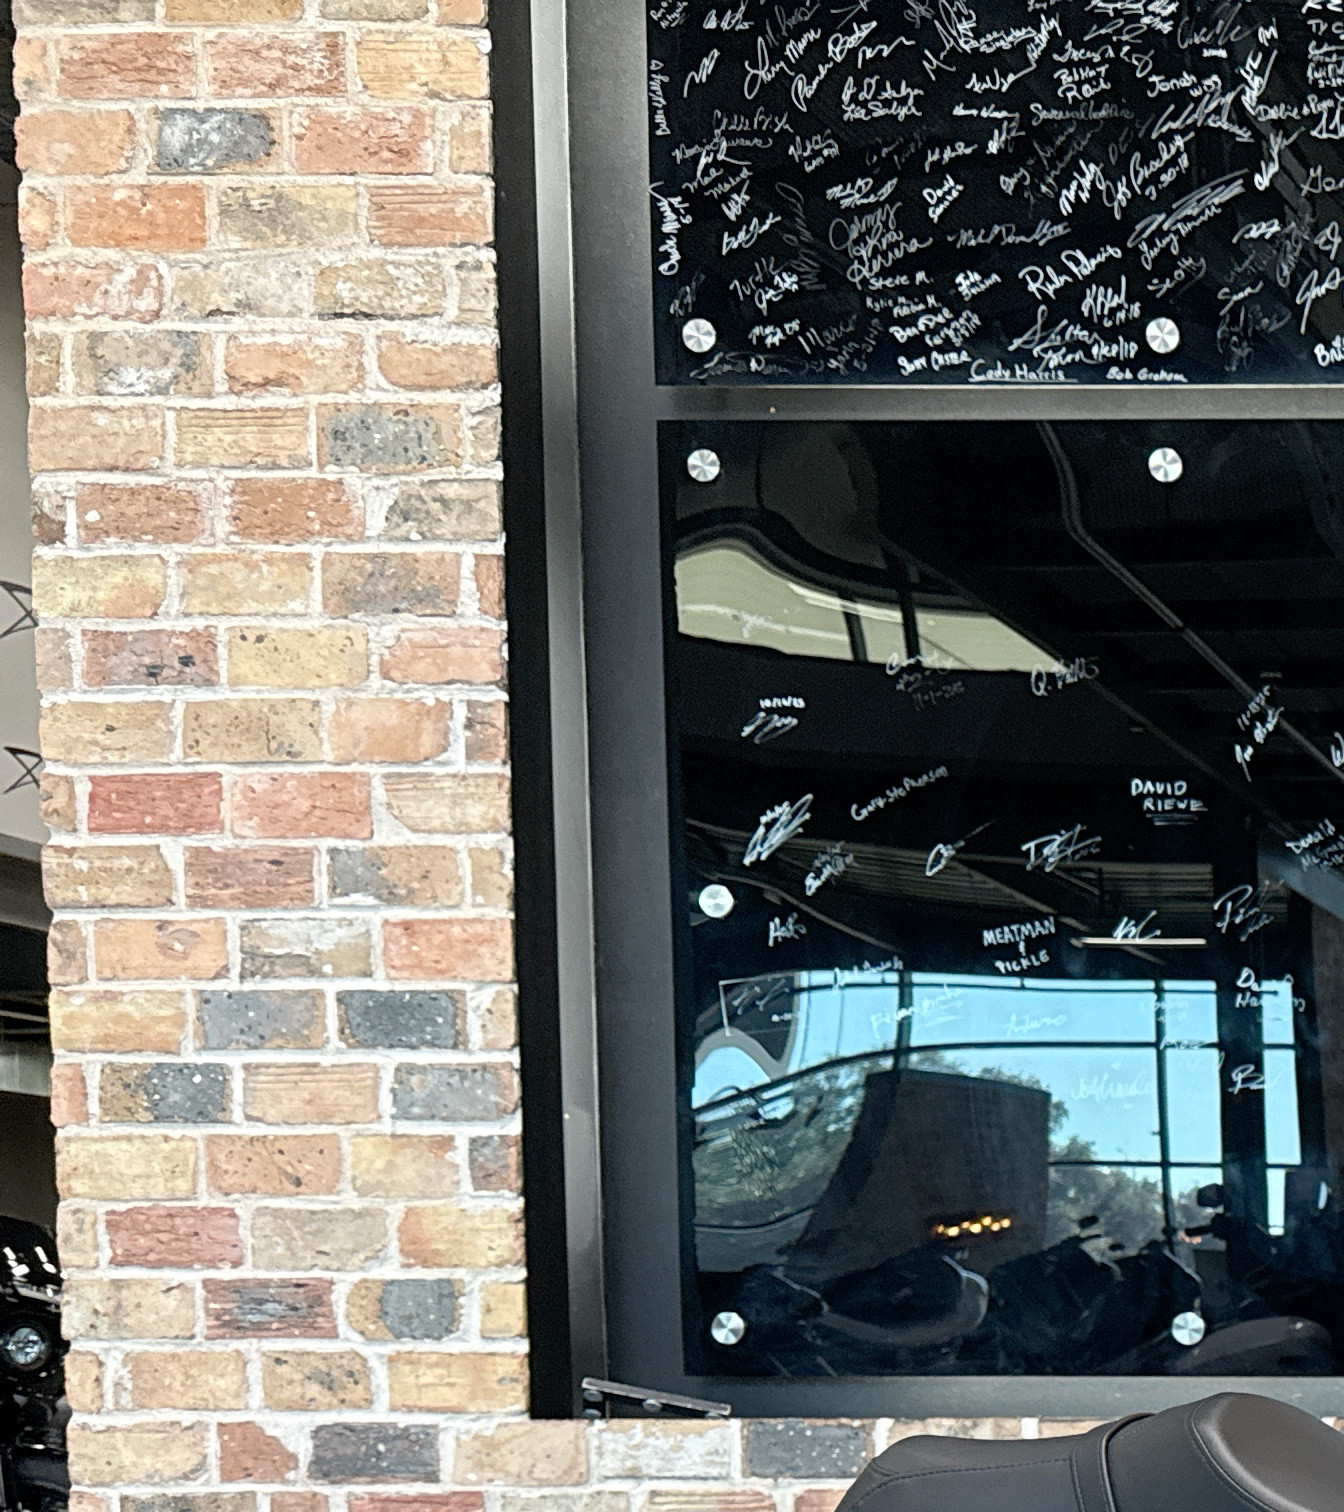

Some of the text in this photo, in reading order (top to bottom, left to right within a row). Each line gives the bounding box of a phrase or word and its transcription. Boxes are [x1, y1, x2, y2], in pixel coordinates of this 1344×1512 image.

[1015, 362, 1067, 381] Harris
[1131, 778, 1188, 796] DAVID
[982, 916, 1056, 948] MEATMAN
[994, 949, 1050, 975] PICKLE
